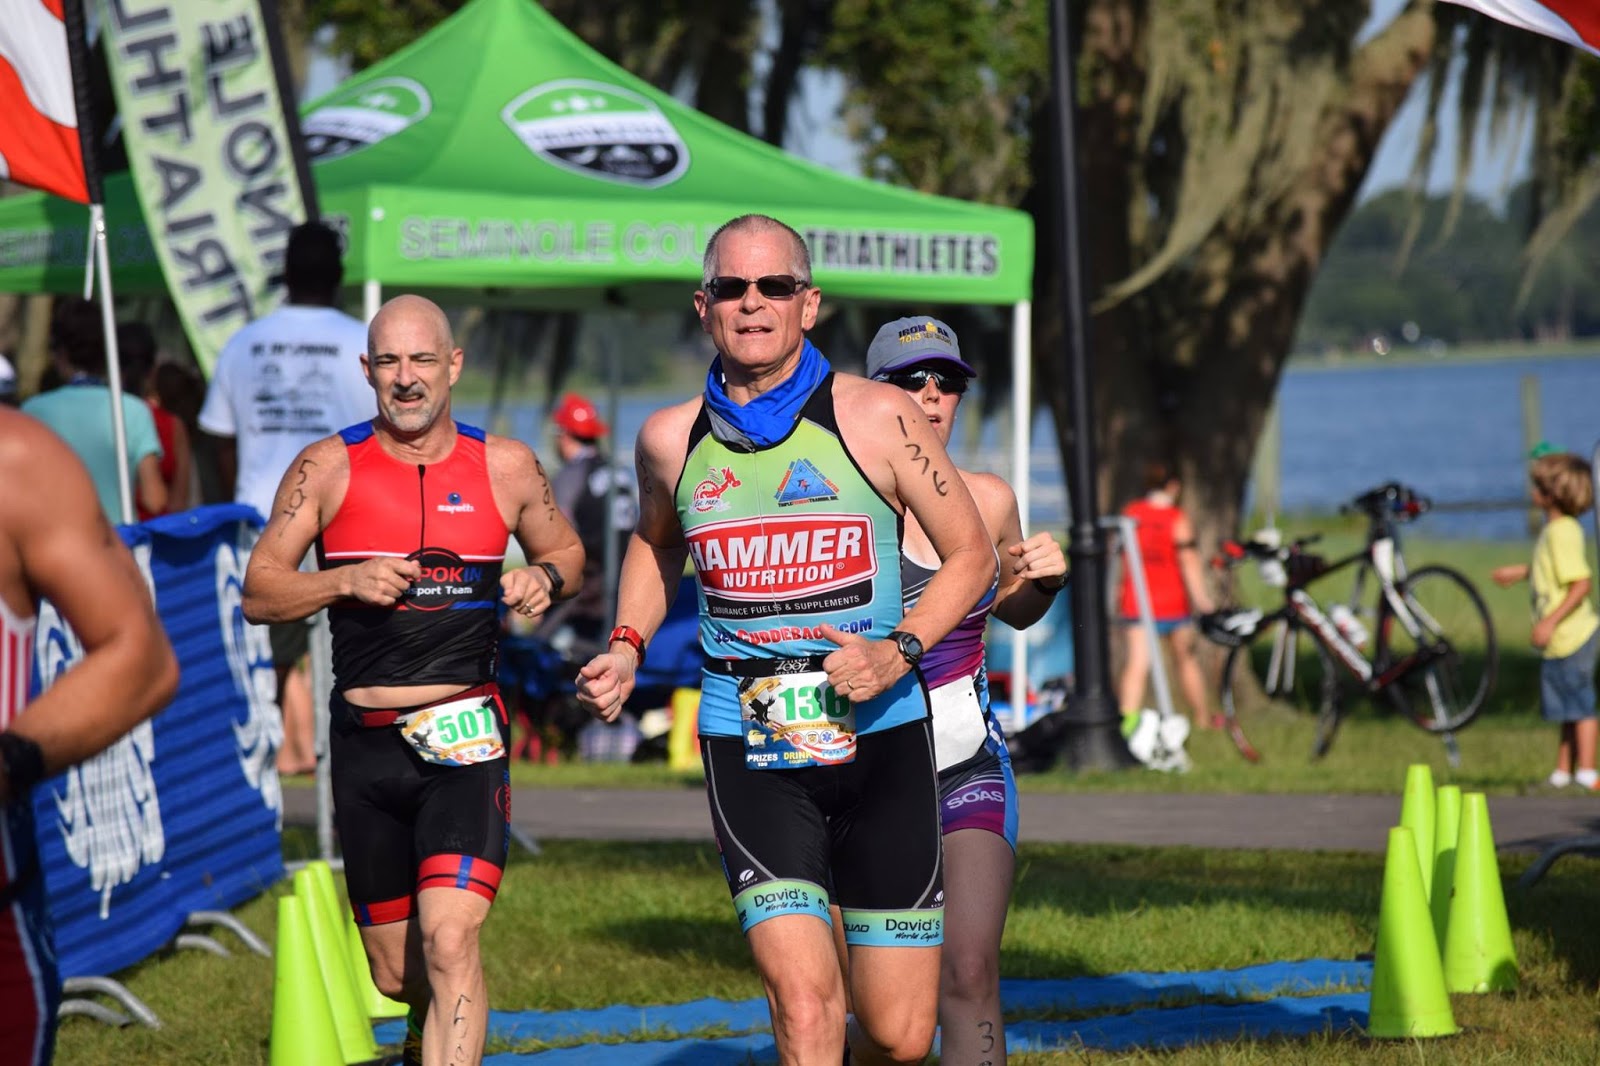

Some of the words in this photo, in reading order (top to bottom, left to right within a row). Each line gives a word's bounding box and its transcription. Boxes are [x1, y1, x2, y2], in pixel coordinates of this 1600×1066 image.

[401, 217, 614, 262] SEMINOLE
[623, 221, 713, 263] COU
[803, 226, 998, 276] TRIATHLETES
[897, 415, 948, 496] 136
[689, 526, 863, 571] HAMMER
[408, 566, 483, 583] POKIN
[445, 586, 473, 595] Team
[784, 603, 794, 611] &
[794, 594, 860, 611] SUPPLEMENTS
[779, 684, 851, 721] 136
[435, 706, 494, 744] 507
[747, 753, 779, 763] PRIZES
[946, 789, 1005, 810] SOAS
[754, 888, 809, 908] David's
[765, 901, 788, 913] World
[788, 900, 810, 911] Cycle
[885, 918, 941, 932] David's
[894, 932, 919, 940] World
